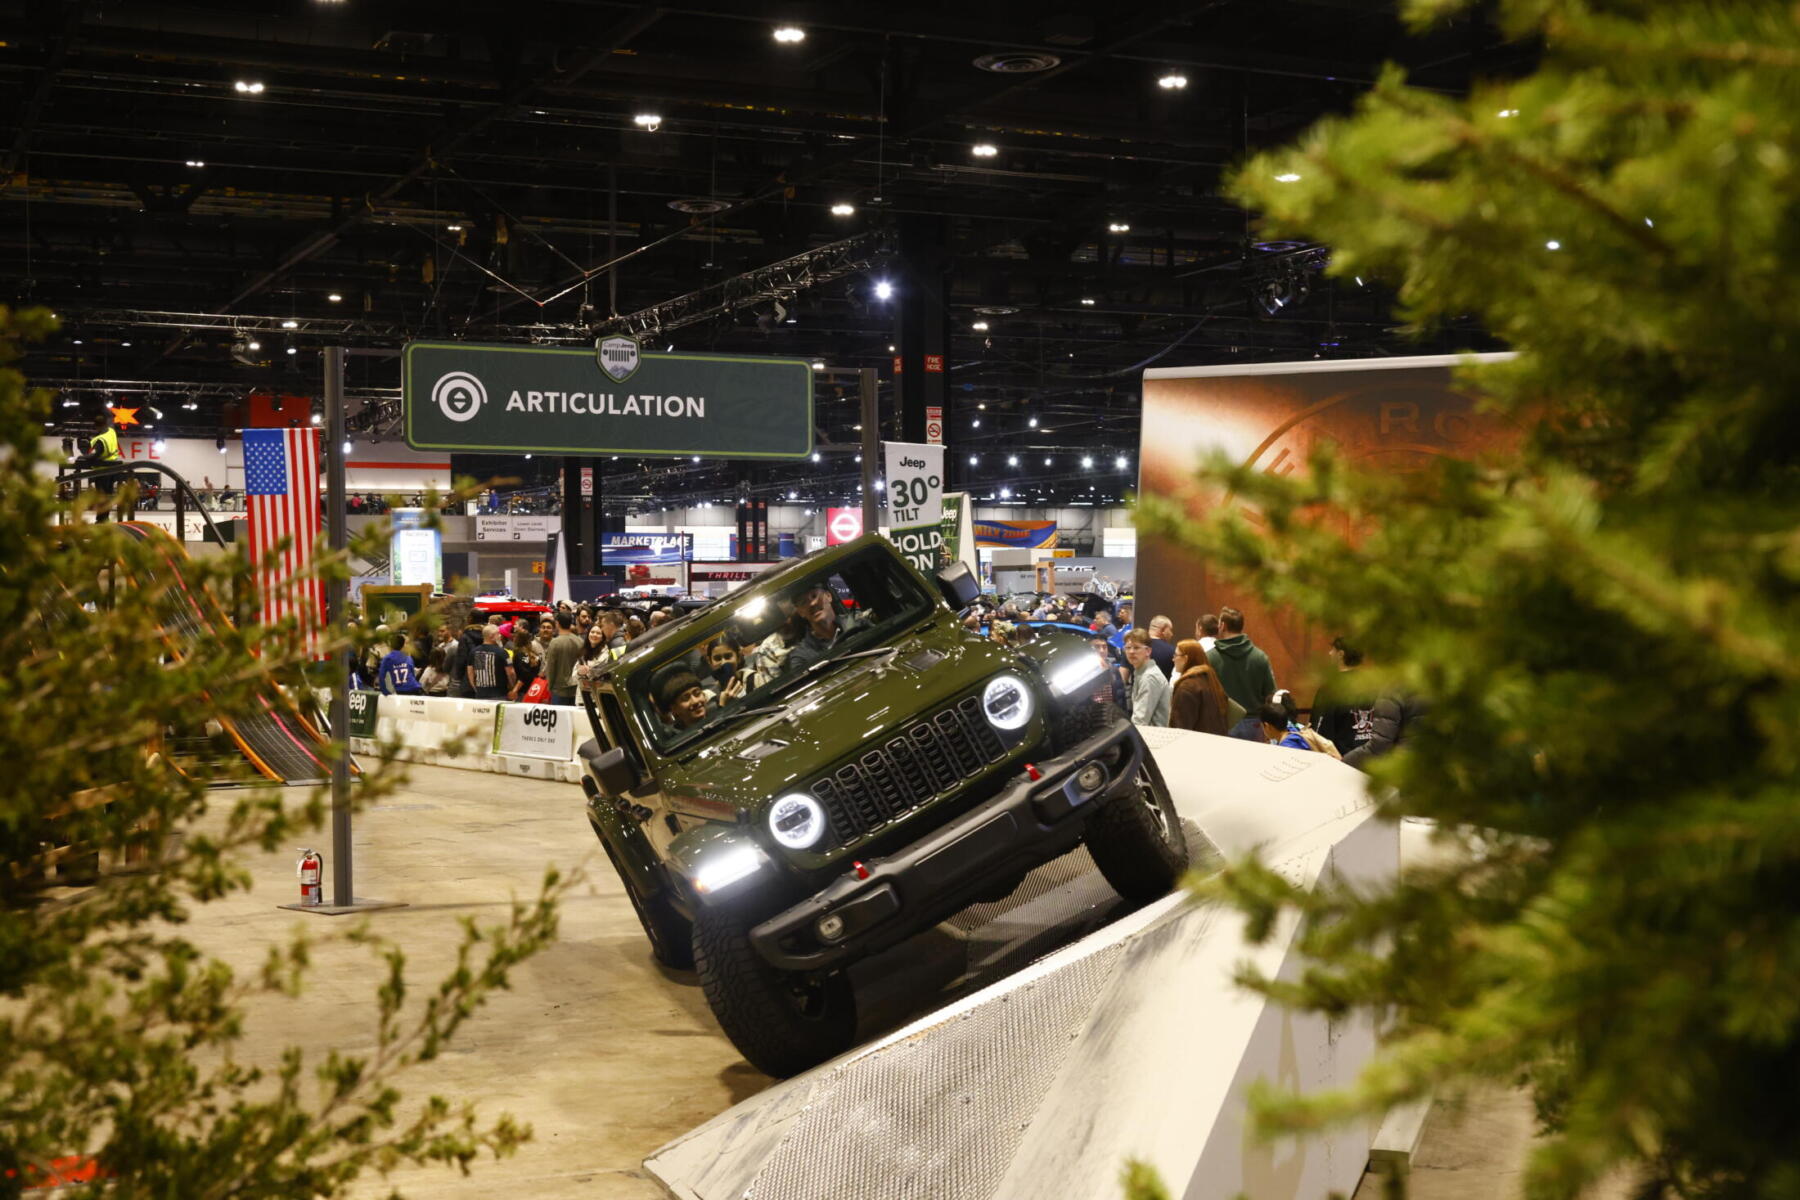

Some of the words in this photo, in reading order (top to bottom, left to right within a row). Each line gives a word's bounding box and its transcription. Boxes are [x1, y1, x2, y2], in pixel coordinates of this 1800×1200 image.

[505, 390, 706, 418] ARTICULATION
[899, 456, 926, 469] Jeep
[890, 475, 940, 508] 30°
[893, 507, 920, 522] TILT
[611, 535, 690, 547] MARKETPLACE
[889, 531, 942, 553] HOLD
[707, 571, 747, 579] THRILL
[393, 668, 408, 684] 17
[349, 691, 367, 715] eep
[523, 705, 557, 732] Jeep
